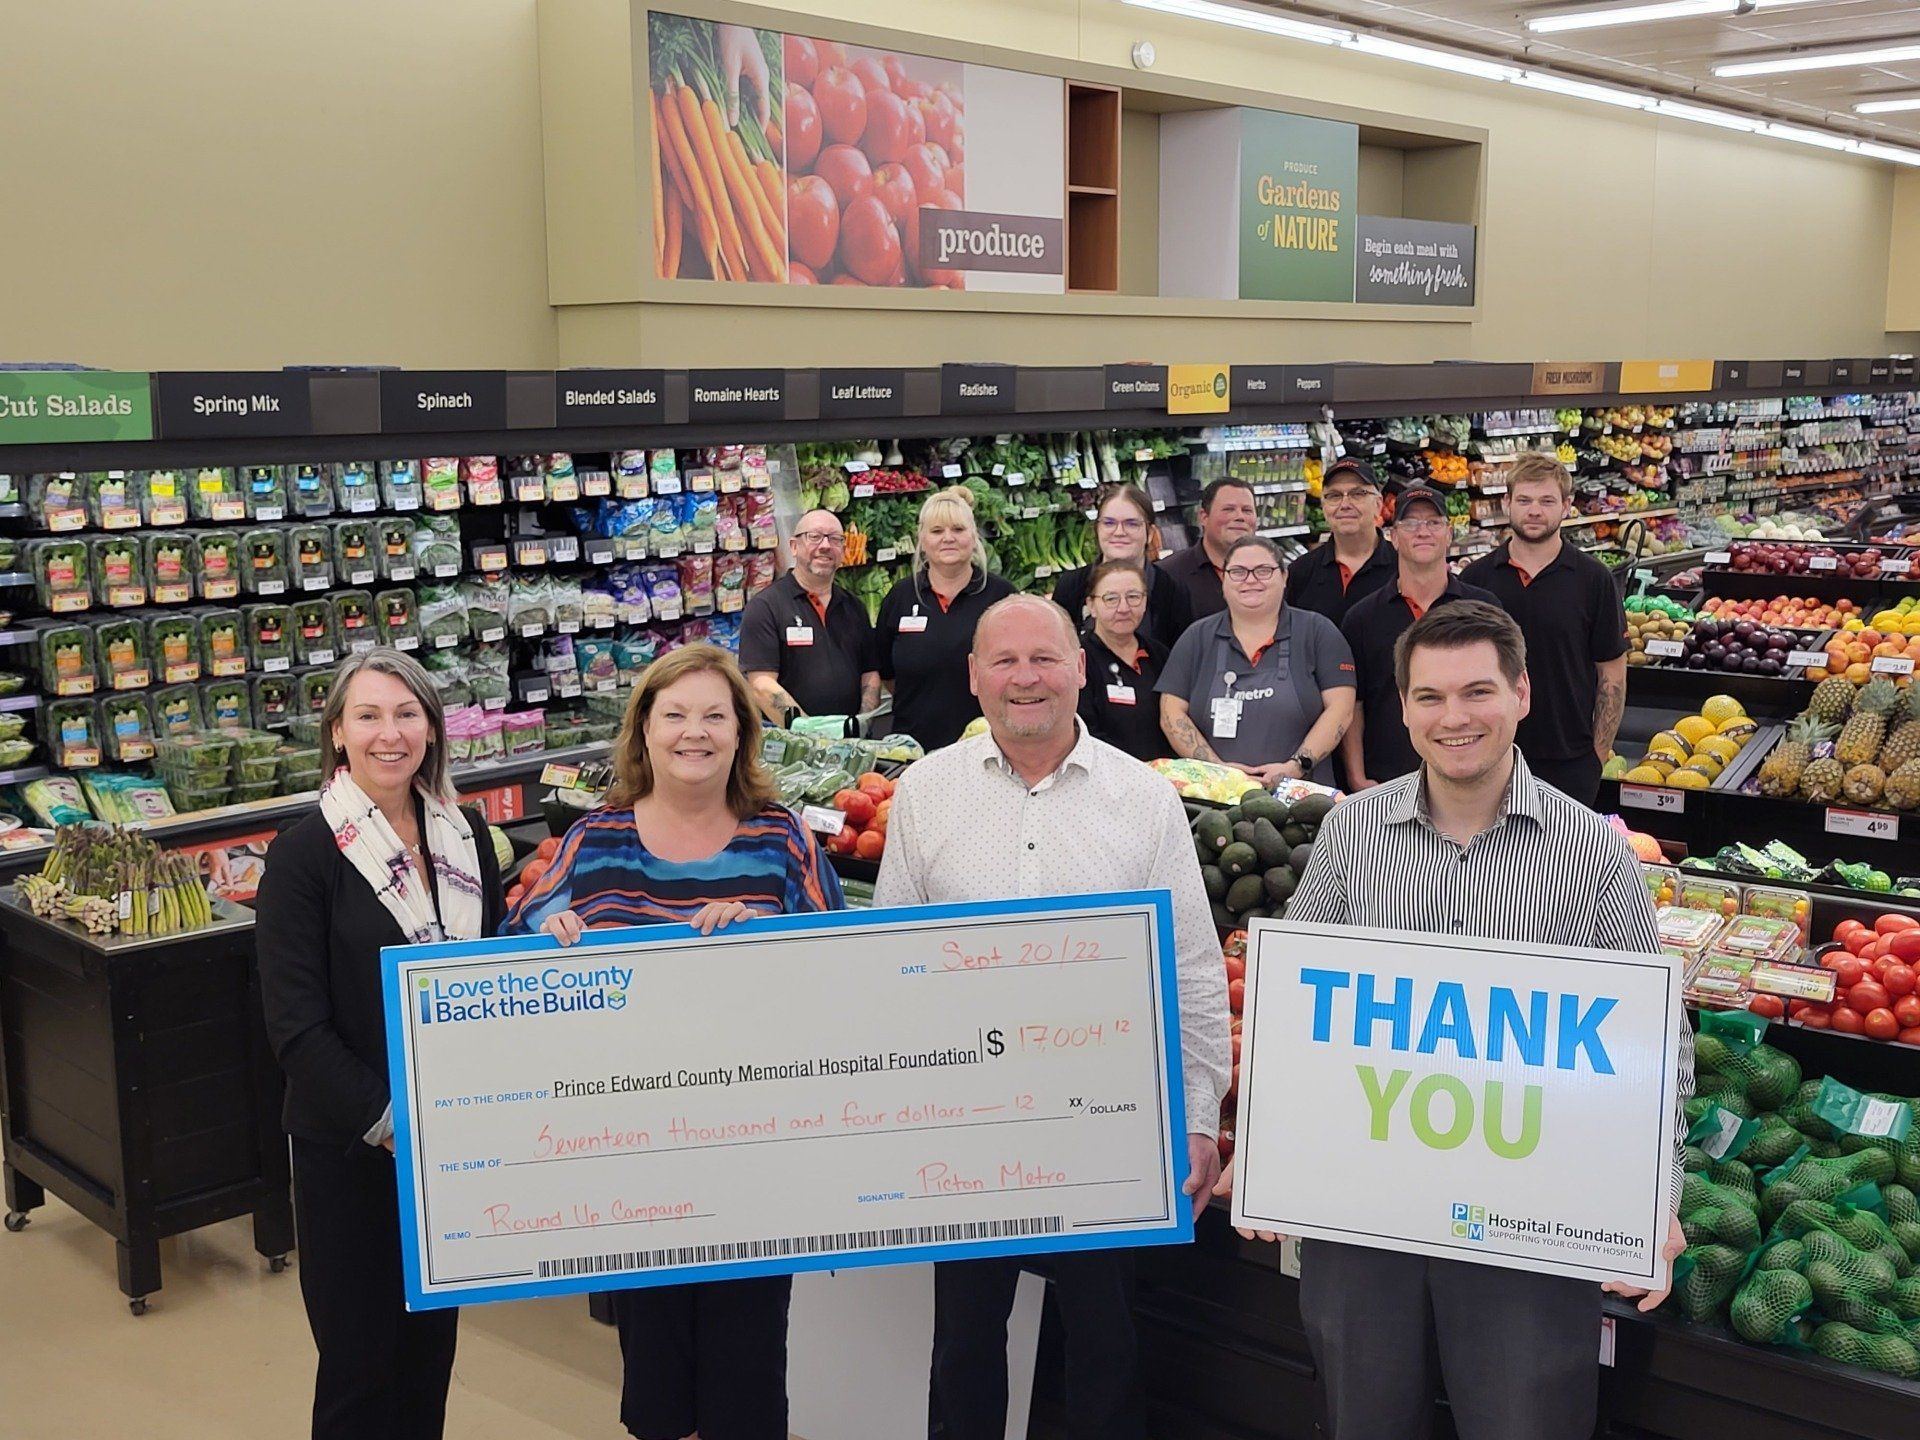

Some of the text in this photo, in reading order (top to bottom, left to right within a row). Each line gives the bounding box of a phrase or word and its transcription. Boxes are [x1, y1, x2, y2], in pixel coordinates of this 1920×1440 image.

[1283, 161, 1318, 175] PRODUCE
[1257, 175, 1340, 212] Gardens
[937, 222, 1046, 263] produce
[1257, 214, 1339, 252] of NATURE
[1365, 238, 1458, 258] Begin each meal with
[1369, 261, 1434, 296] something
[694, 386, 780, 403] Romaine Hearts
[832, 385, 892, 400] Leaf Lettuce
[959, 383, 998, 397] Radishes
[1112, 380, 1160, 393] Green Onions
[1170, 381, 1212, 399] Organic
[1247, 379, 1267, 390] Herbs
[1296, 378, 1322, 391] Peppers
[46, 394, 133, 417] Salads
[193, 395, 280, 416] Spring Mix
[417, 392, 472, 411] Spinach
[565, 389, 656, 406] Blended Salads
[1233, 687, 1274, 701] metro
[942, 940, 1003, 978] Sept
[901, 964, 927, 975] DATE
[433, 977, 494, 1000] Love
[498, 972, 539, 994] the
[541, 965, 634, 992] County
[436, 987, 606, 1023] Back the Build
[1114, 1019, 1131, 1034] 12
[1300, 967, 1619, 1075] THANK
[986, 1027, 1006, 1058] $
[553, 1046, 978, 1098] Prince Edward County Memorial Hospital Foundation
[434, 1090, 549, 1108] PAY TO THE ORDER OF
[1090, 1102, 1137, 1116] DOLLARS
[1354, 1064, 1543, 1160] YOU
[533, 1094, 1035, 1160] Seventeen thousand and four dollars 12
[439, 1158, 502, 1172] THE SUM OF
[915, 1161, 1067, 1195] Picton Metro
[857, 1191, 906, 1203] SIGNATURE
[483, 1199, 695, 1234] Round Up Campaign
[444, 1230, 472, 1241] MEMO
[1488, 1213, 1645, 1248] Hospital Foundation
[1488, 1230, 1644, 1260] SUPPORTING YOUR COUNTY HOSPITAL
